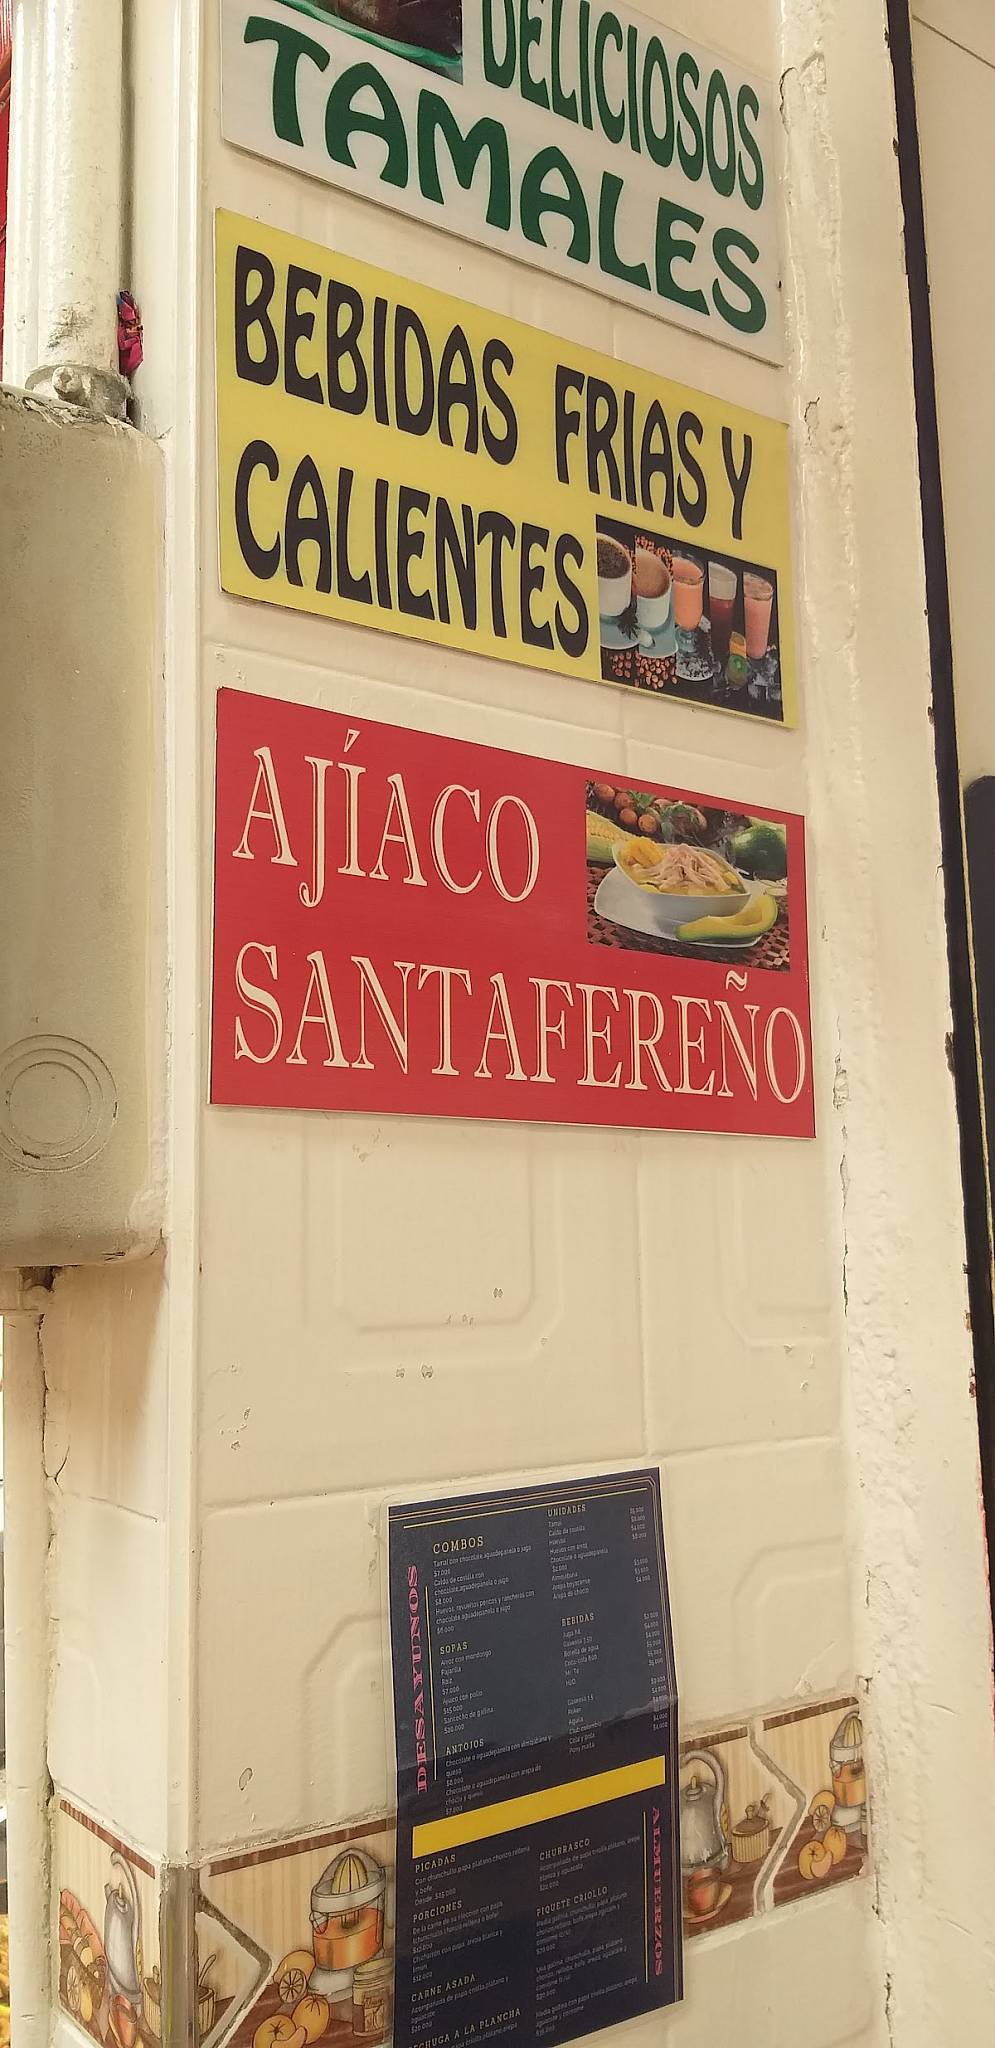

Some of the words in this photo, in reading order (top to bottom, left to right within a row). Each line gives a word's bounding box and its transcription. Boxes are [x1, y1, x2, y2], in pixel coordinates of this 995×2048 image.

[243, 15, 767, 334] TAMALES
[234, 245, 519, 466] BEBIDAS
[554, 364, 708, 529] FRIAS
[720, 425, 753, 540] Y
[234, 440, 590, 658] CALIENTES
[232, 729, 540, 908] AJÍACO
[234, 941, 806, 1104] SANTAFEREÑO
[547, 1504, 586, 1518] UNIDADES
[433, 1536, 484, 1554] COMBOS
[561, 1612, 595, 1627] BEBIDAS
[440, 1641, 469, 1656] SOPAS
[408, 1565, 427, 1796] DESAYUNOS
[446, 1737, 485, 1756] ANTOJOS
[415, 1853, 456, 1873] PICADAS
[539, 1838, 590, 1861] CHURRASCO
[412, 1900, 462, 1924] PORCIONES
[536, 1898, 571, 1917] PIQUETE
[573, 1886, 608, 1904] CRIOLLO
[411, 1985, 442, 2002] CARNE
[445, 1973, 476, 1992] ASADA
[454, 2029, 461, 2039] A
[464, 2024, 476, 2036] LA
[479, 2008, 521, 2030] PLANCHA
